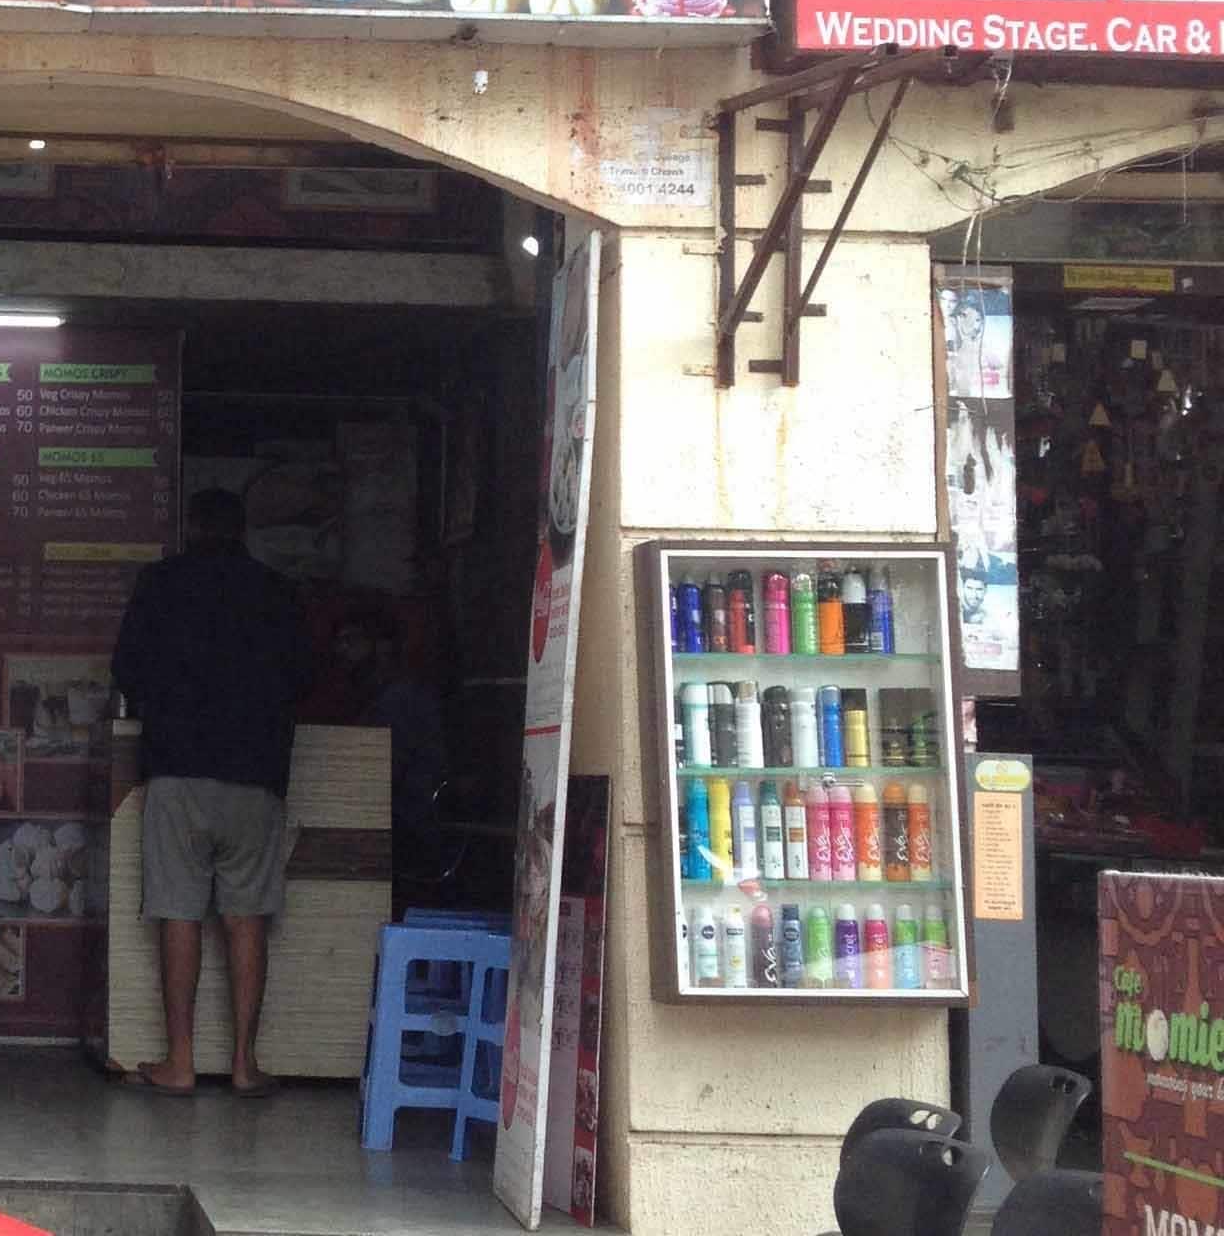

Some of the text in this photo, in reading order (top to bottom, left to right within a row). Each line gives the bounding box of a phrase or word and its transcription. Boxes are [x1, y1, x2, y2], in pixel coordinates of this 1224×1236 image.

[1185, 19, 1212, 54] &
[16, 389, 33, 402] 50
[15, 405, 33, 418] 60
[16, 421, 33, 434] 70
